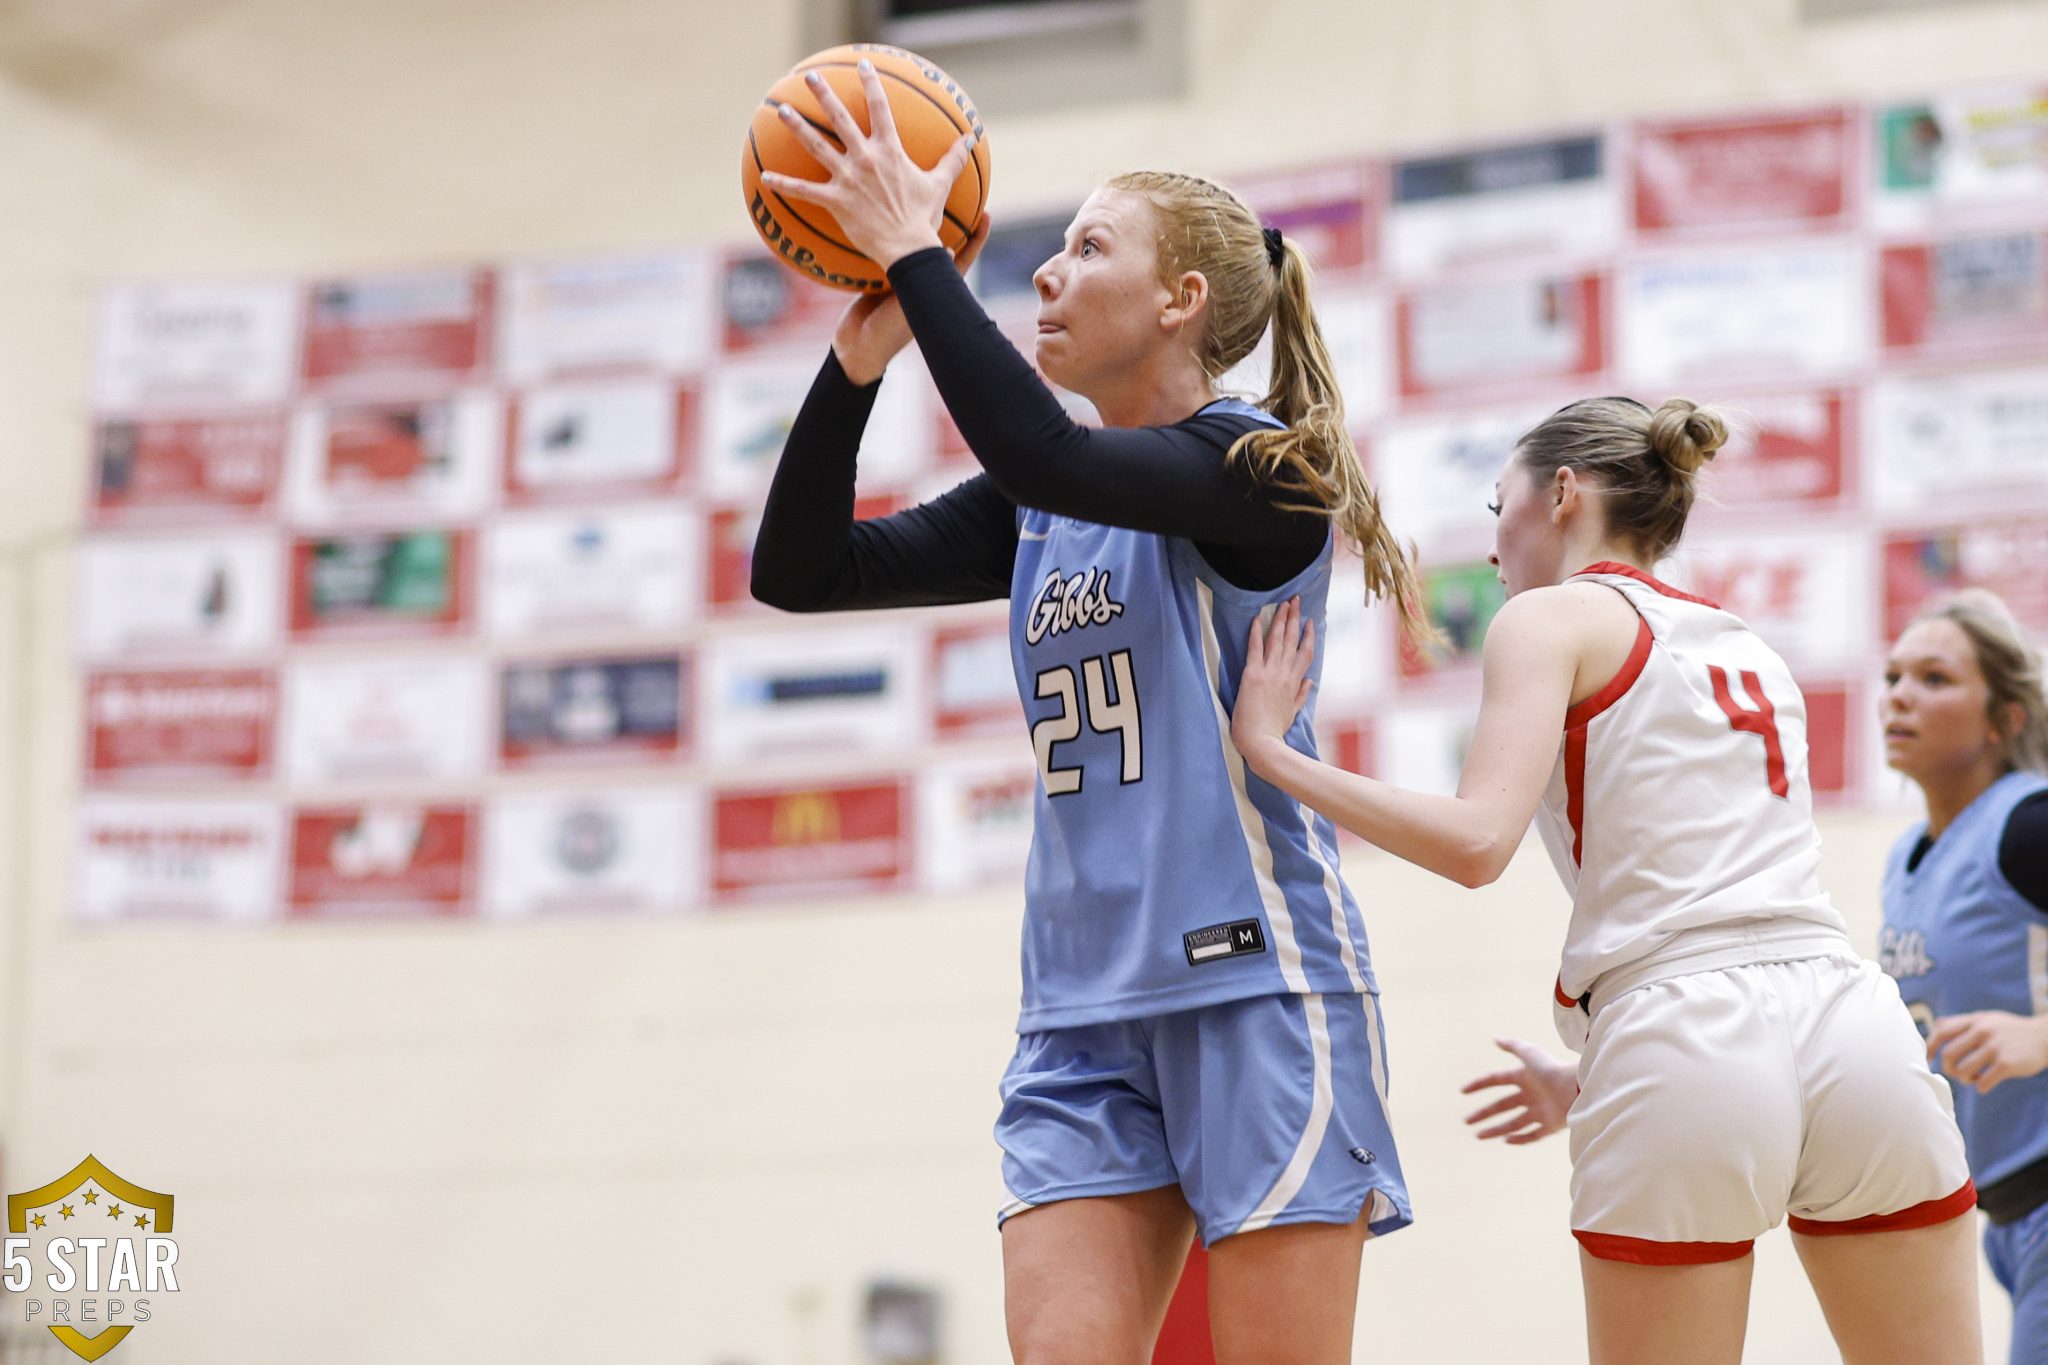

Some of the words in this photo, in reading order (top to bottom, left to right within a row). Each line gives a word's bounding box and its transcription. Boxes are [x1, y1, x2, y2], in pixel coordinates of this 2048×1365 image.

[751, 189, 884, 290] Wilson
[1026, 567, 1125, 645] Gibbs
[1033, 648, 1143, 799] 24
[1705, 663, 1790, 802] 4
[1239, 929, 1254, 945] M
